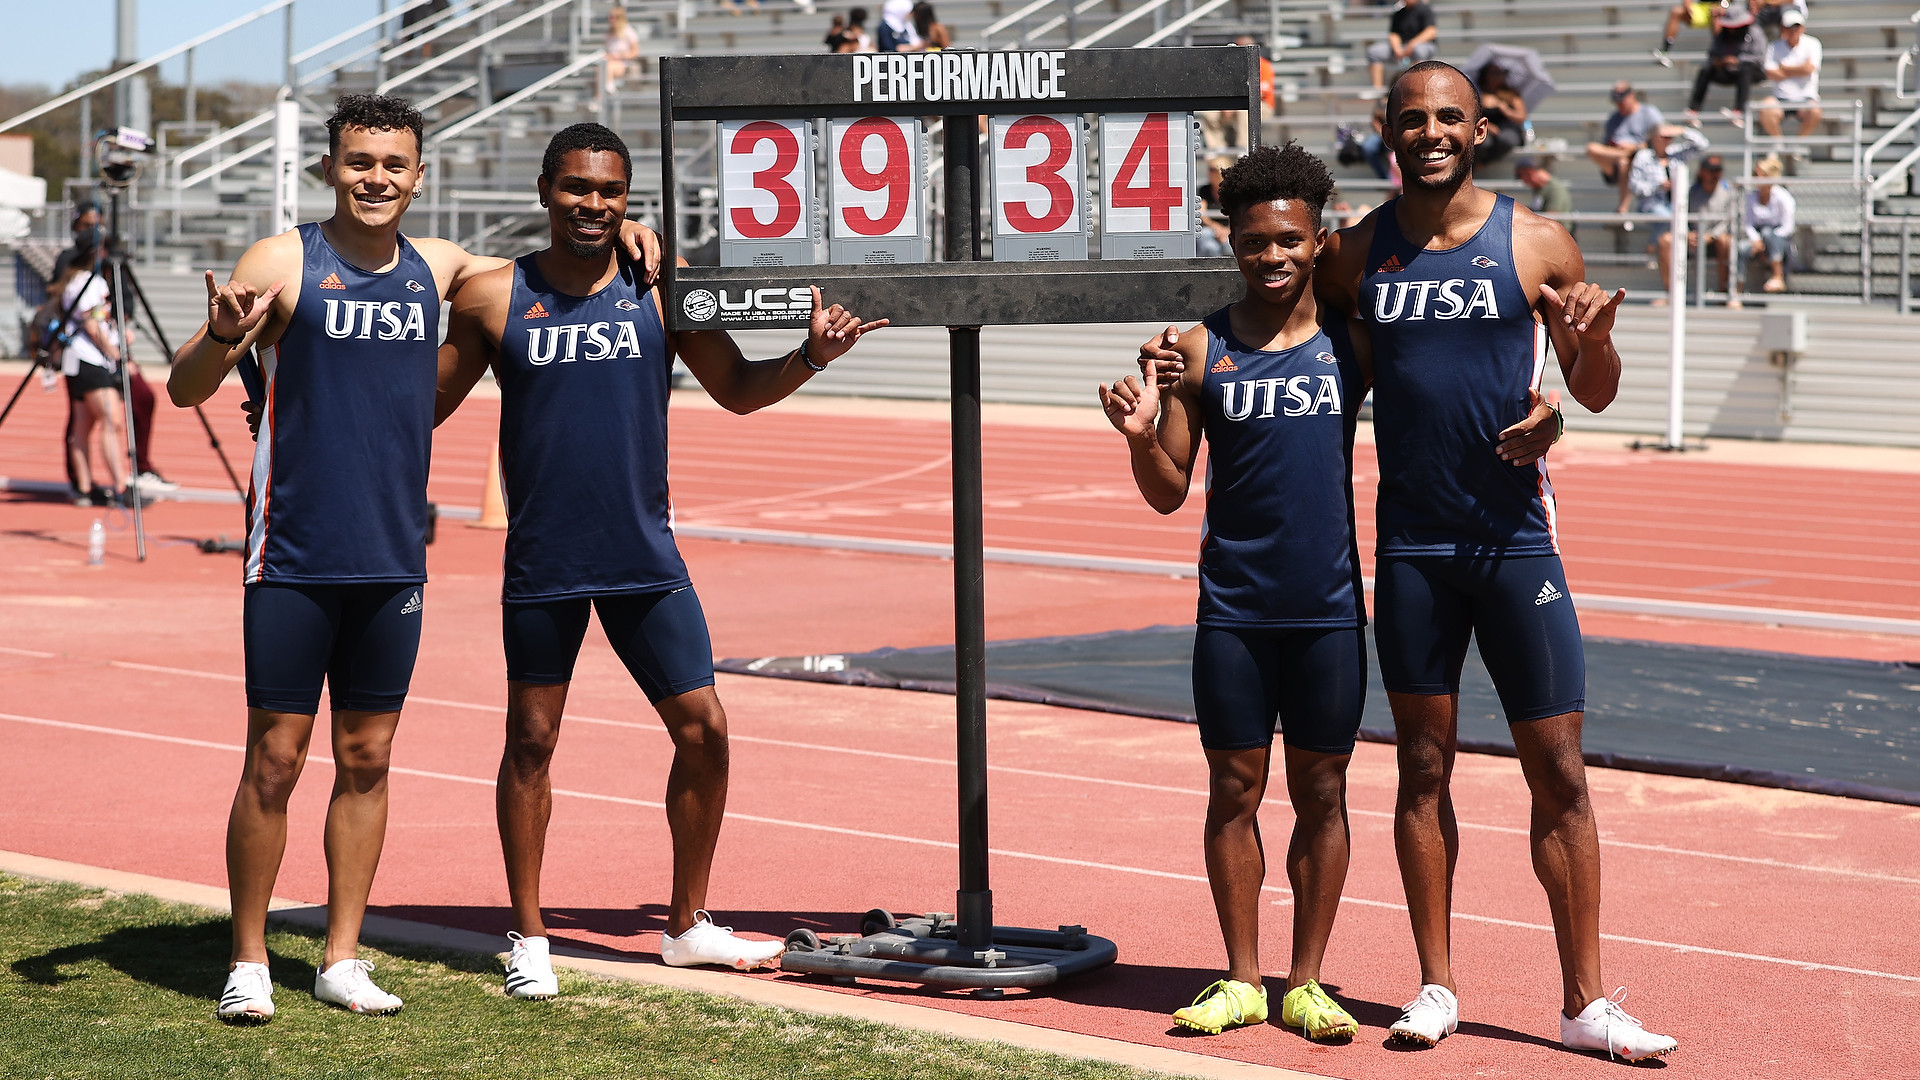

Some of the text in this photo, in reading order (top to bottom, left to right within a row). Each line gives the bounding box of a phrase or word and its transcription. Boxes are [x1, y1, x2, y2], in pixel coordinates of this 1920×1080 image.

[853, 51, 1066, 102] PERFORMANCE
[319, 282, 347, 290] adidas
[719, 287, 821, 311] UCS
[1375, 278, 1500, 323] UTSA
[323, 299, 426, 341] UTSA
[523, 311, 550, 320] adidas
[526, 320, 643, 366] UTSA
[1211, 365, 1239, 374] adidas
[1220, 375, 1342, 421] UTSA
[400, 602, 423, 615] adida
[1535, 591, 1563, 606] adidas
